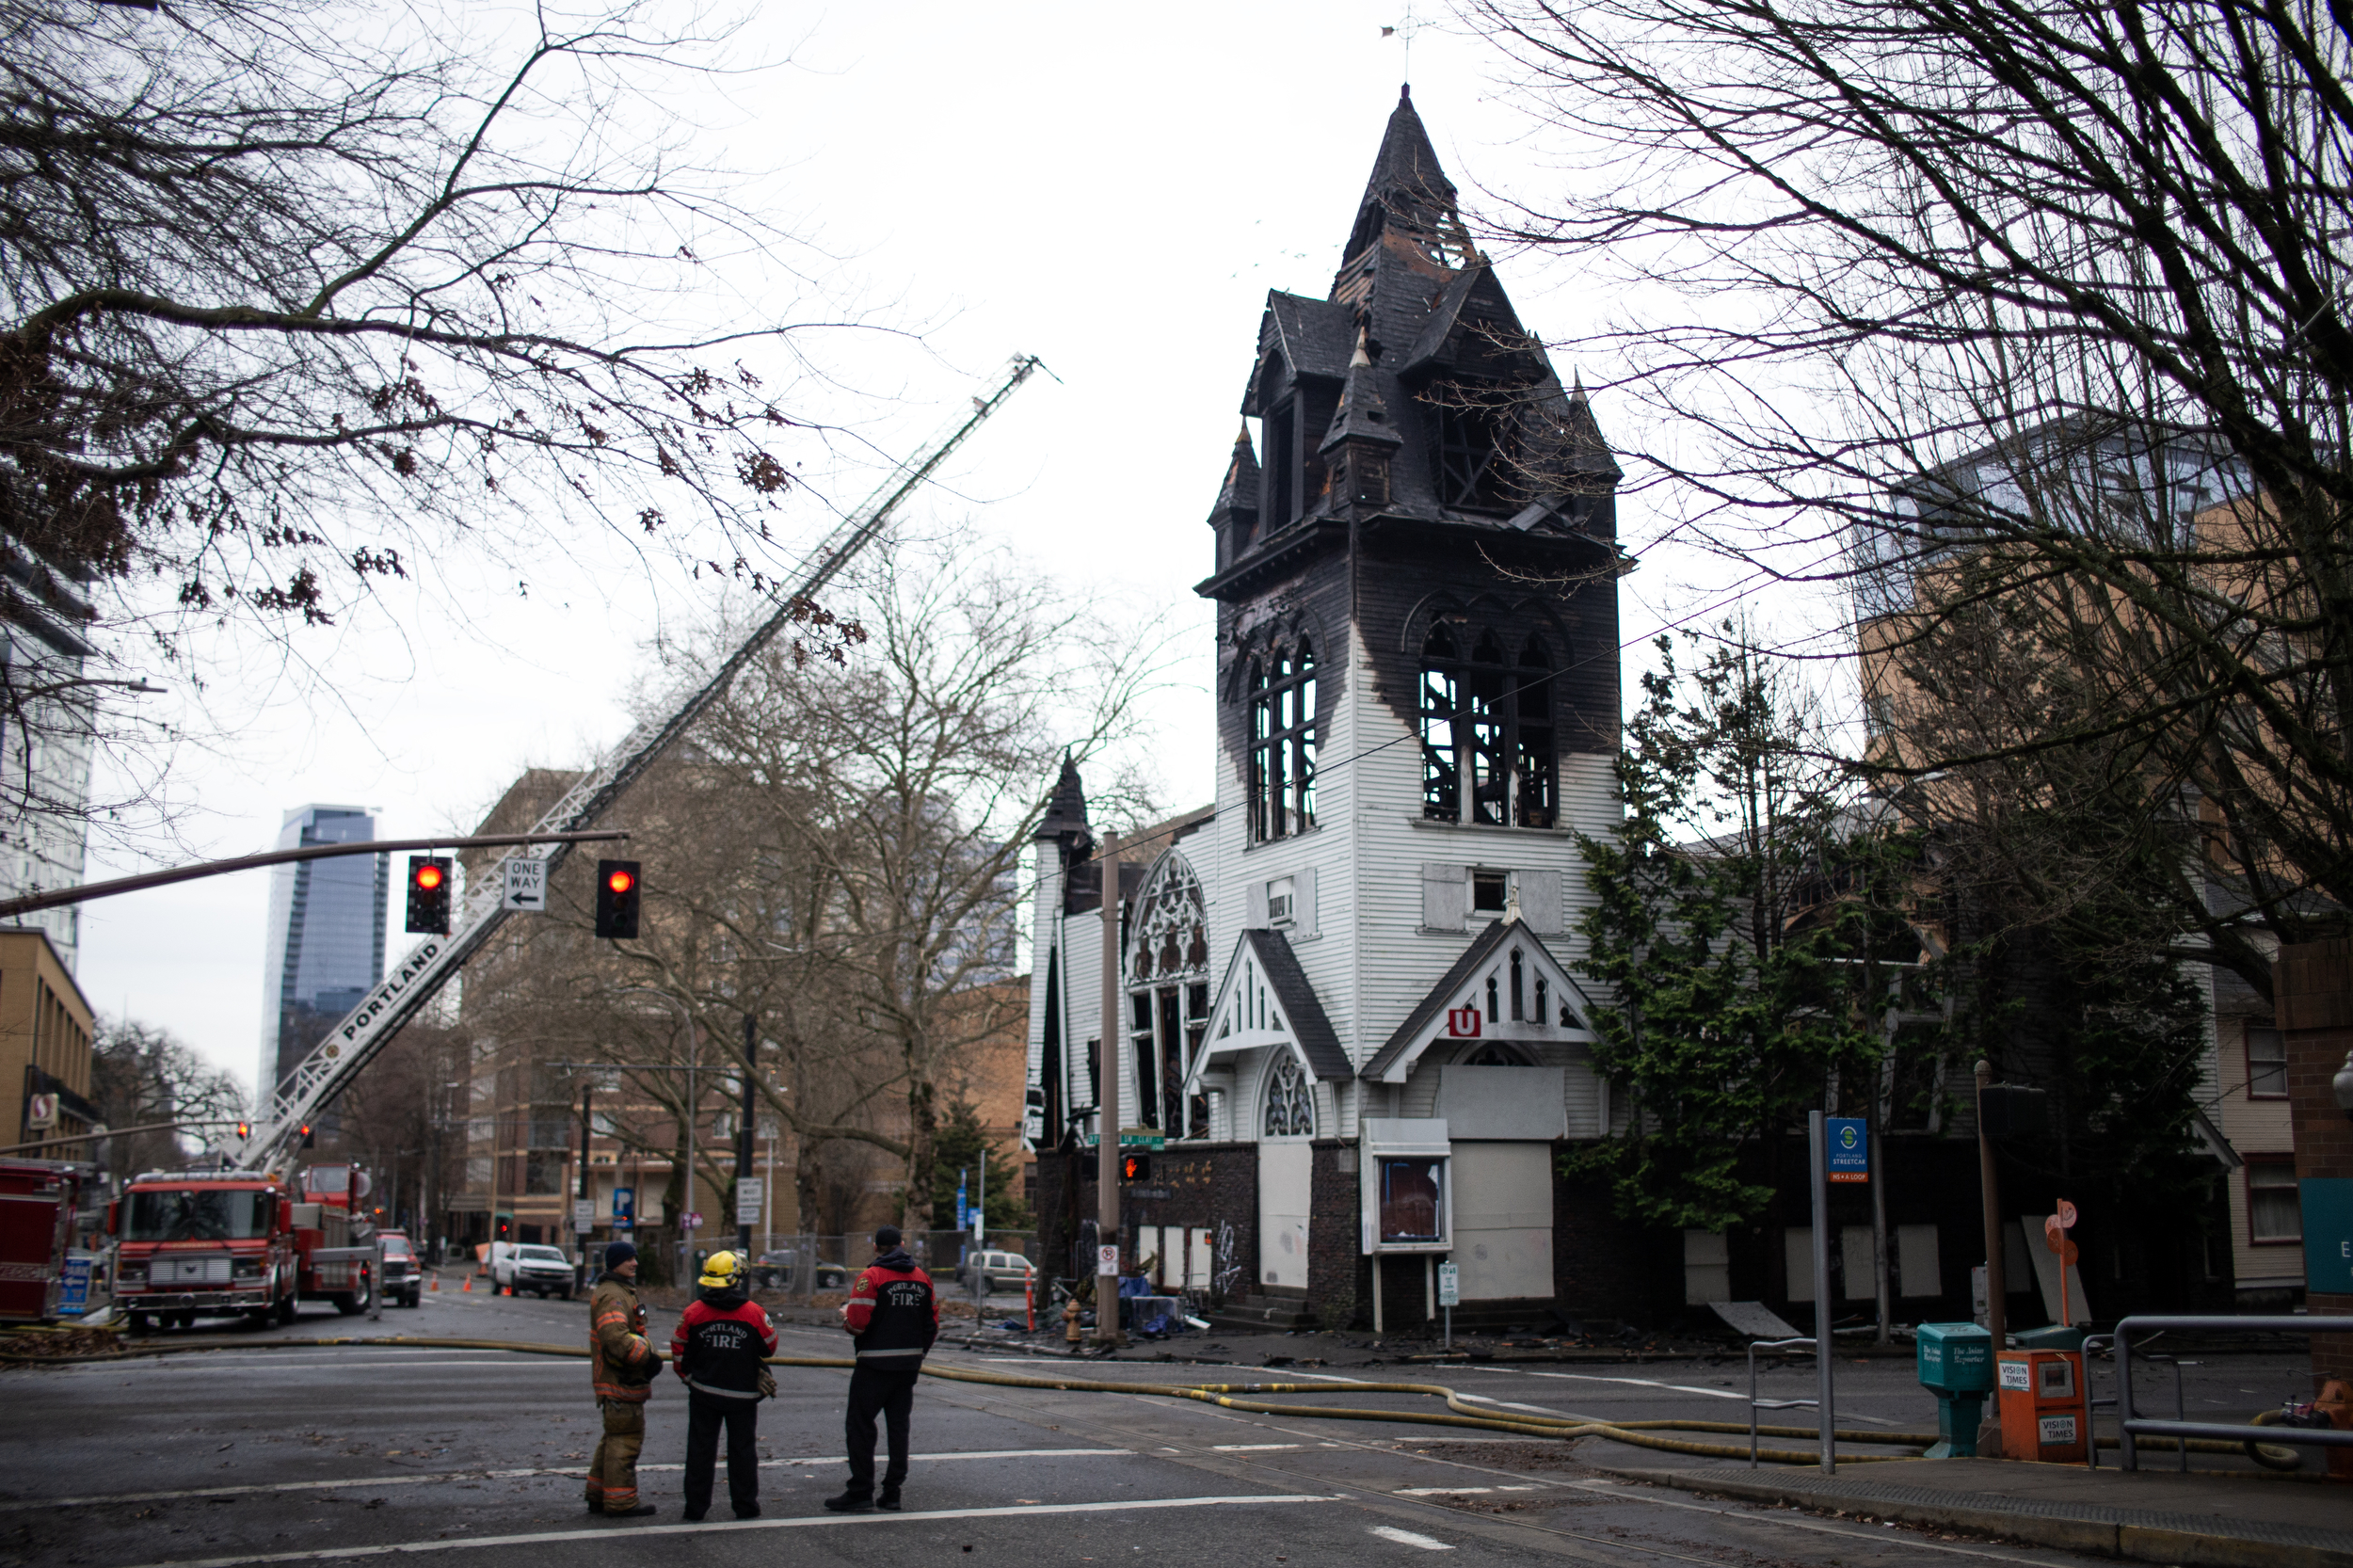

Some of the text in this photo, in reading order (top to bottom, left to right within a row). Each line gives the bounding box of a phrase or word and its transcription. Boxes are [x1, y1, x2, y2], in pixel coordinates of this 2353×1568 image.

[512, 862, 540, 875] ONE
[511, 876, 541, 889] WAY
[343, 944, 439, 1041] PORTLAND
[1455, 1011, 1475, 1035] U
[1138, 1136, 1153, 1144] CLAY
[617, 1192, 632, 1212] P
[888, 1282, 927, 1296] PORTLAND
[891, 1293, 922, 1306] FIRE
[698, 1322, 748, 1339] PORTLAND
[705, 1335, 742, 1349] FIRE
[1953, 1346, 1985, 1355] The Asian
[1954, 1355, 1985, 1366] Reporter
[2002, 1366, 2027, 1375] VISION
[2006, 1375, 2028, 1384] TIMES
[2042, 1419, 2073, 1430] VISION
[2047, 1430, 2073, 1439] TIMES
